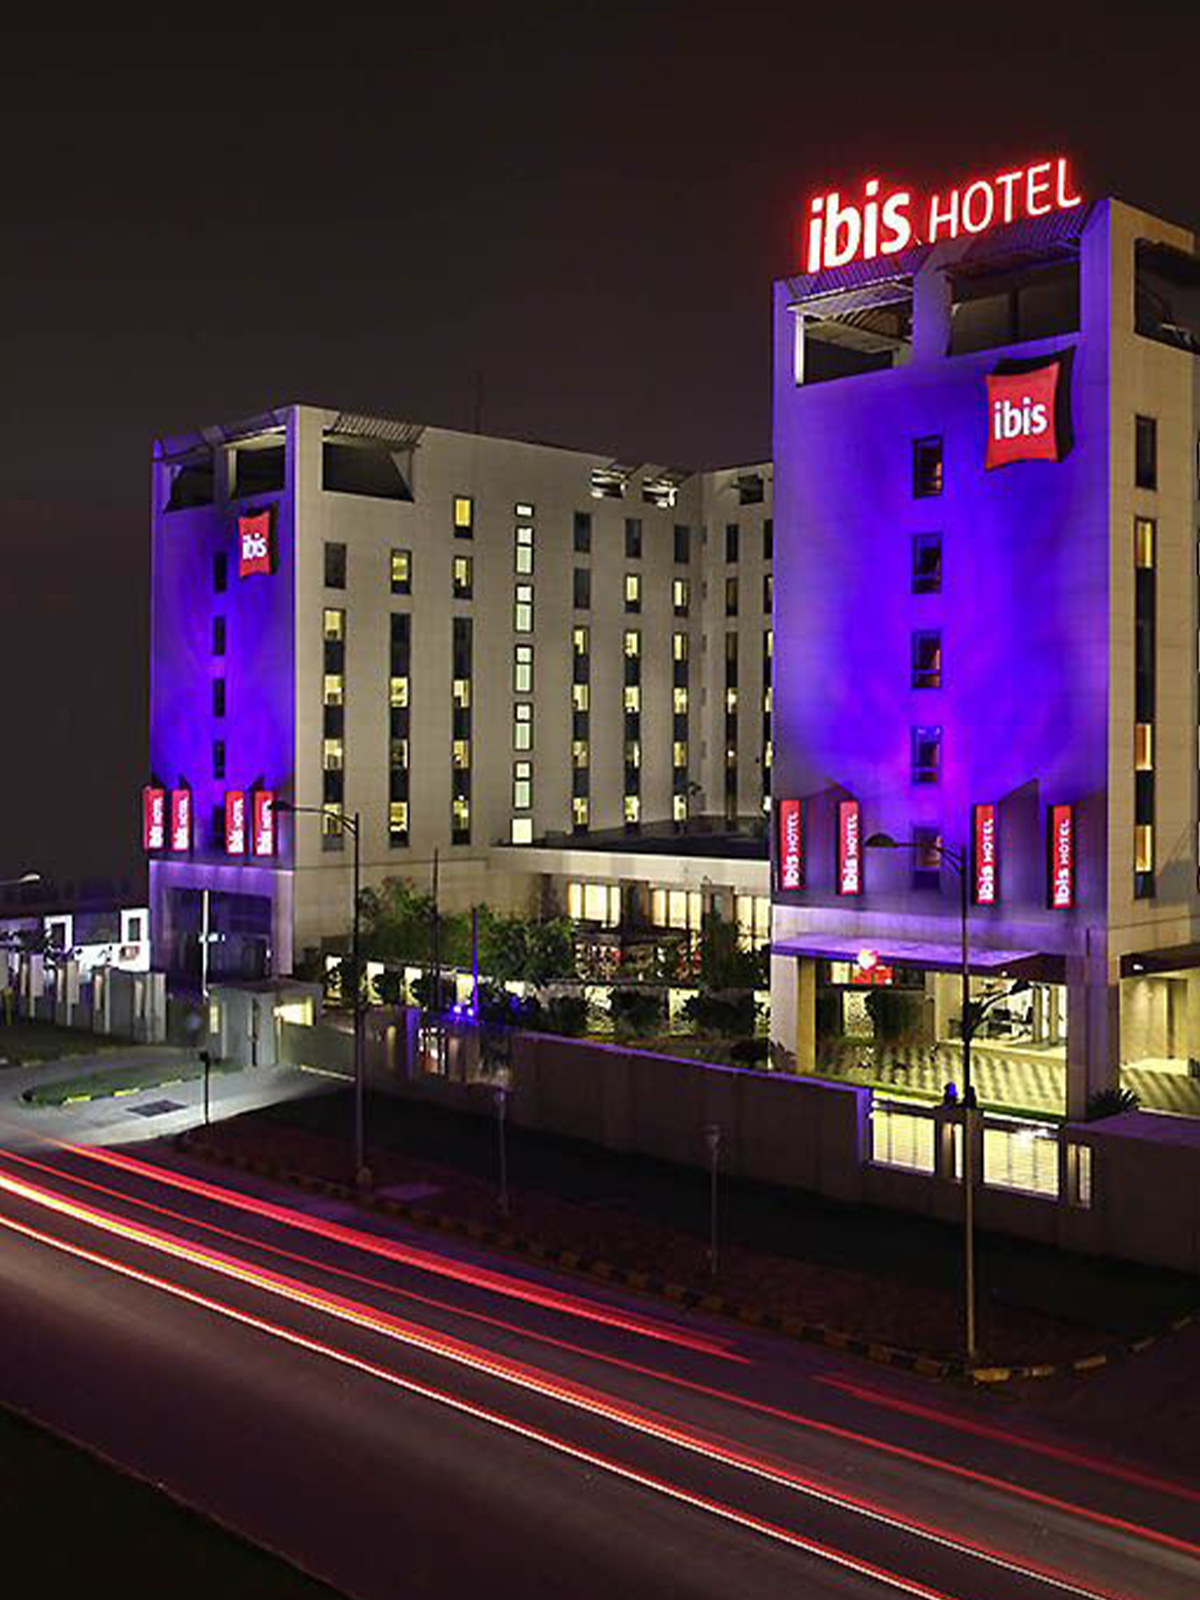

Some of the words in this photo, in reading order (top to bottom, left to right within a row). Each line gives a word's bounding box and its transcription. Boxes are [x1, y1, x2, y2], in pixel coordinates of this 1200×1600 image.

[807, 180, 912, 273] ibis
[929, 158, 1081, 243] HOTEL
[993, 396, 1048, 440] ibis
